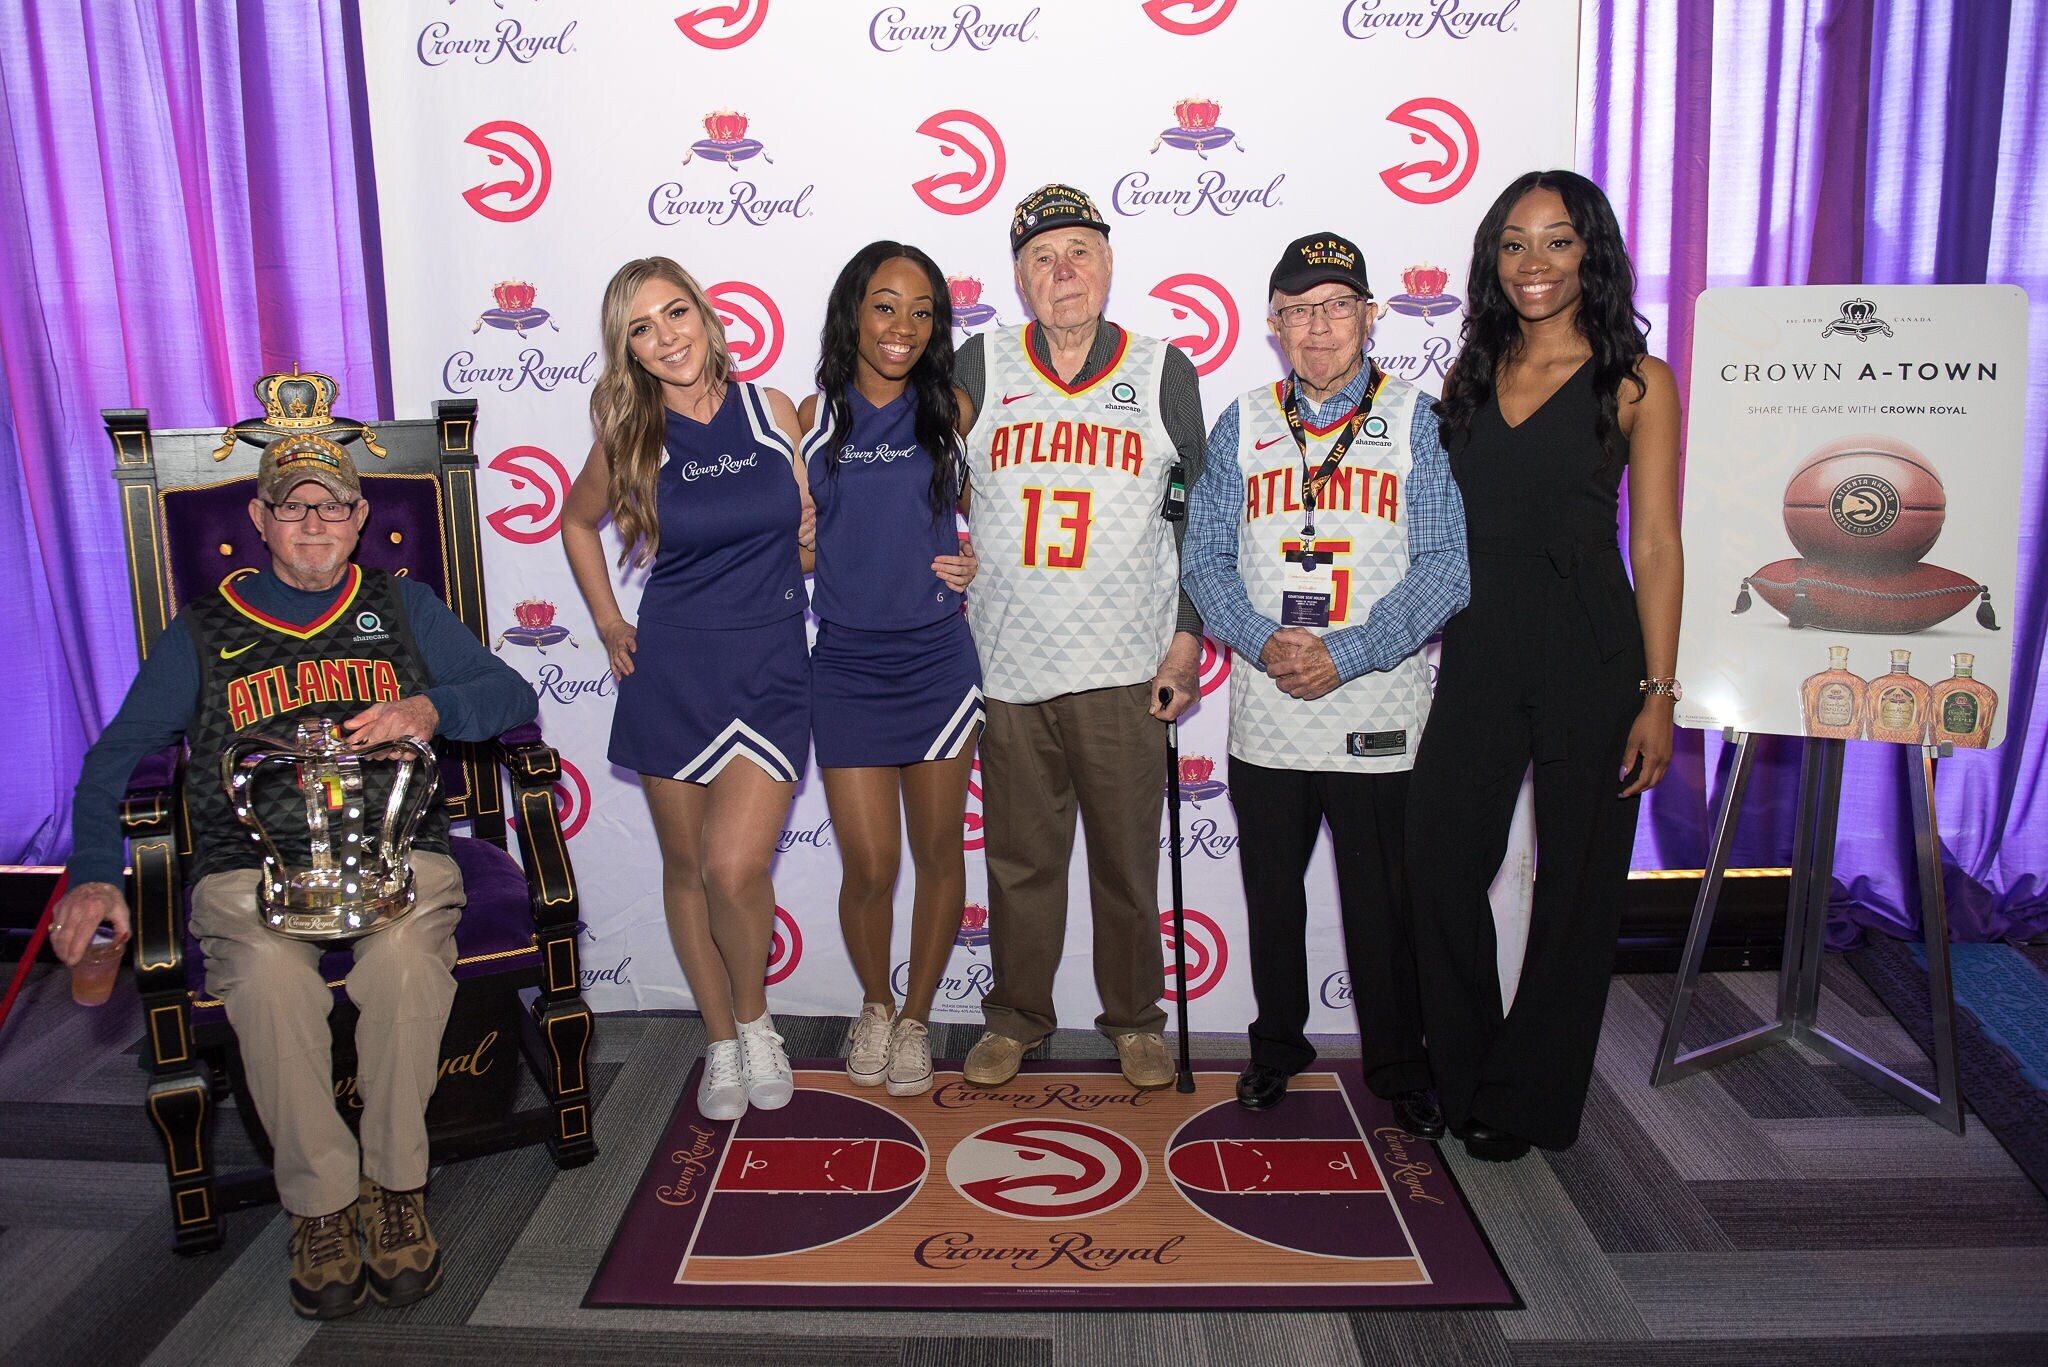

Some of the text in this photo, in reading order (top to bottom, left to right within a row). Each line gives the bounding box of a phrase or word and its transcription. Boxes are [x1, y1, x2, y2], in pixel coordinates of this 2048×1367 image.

[869, 4, 1040, 52] Crown Royal
[1342, 0, 1520, 39] Crown Royal
[417, 18, 578, 67] Crown Royal
[648, 181, 815, 226] Crown Royal
[1027, 188, 1086, 210] USS GEARING
[1112, 170, 1286, 217] Crown Royal
[1042, 206, 1076, 217] DD-710
[1301, 240, 1356, 262] KOREA
[1307, 256, 1353, 270] VETERAN
[1366, 337, 1417, 370] own
[442, 348, 598, 394] Crown Royal
[1720, 362, 1998, 382] CROWN A-TOWN
[1105, 403, 1141, 413] sharecare
[1748, 405, 1968, 415] SHARE THE GAME WITH CROWN ROYAL
[272, 433, 344, 460] MARINE
[838, 443, 917, 464] Crown Royal
[990, 420, 1144, 477] ATLANTA
[1355, 438, 1393, 447] sharecare
[682, 452, 758, 482] Crown Royal
[1835, 479, 1895, 501] ATLANTA HAWKS
[1021, 485, 1095, 571] 13
[1834, 508, 1895, 534] BASKETBALL CLUB
[353, 634, 390, 642] sharecare
[227, 658, 401, 732] ATLANTA
[775, 818, 832, 853] oyal
[1168, 818, 1241, 860] Roy
[288, 915, 337, 930] Crown Royal
[580, 956, 632, 991] oyal
[932, 1081, 1153, 1112] Crown Royal
[656, 1125, 716, 1206] Crown Royal
[1384, 1153, 1445, 1205] Royal
[913, 1231, 1186, 1271] Crown Royal
